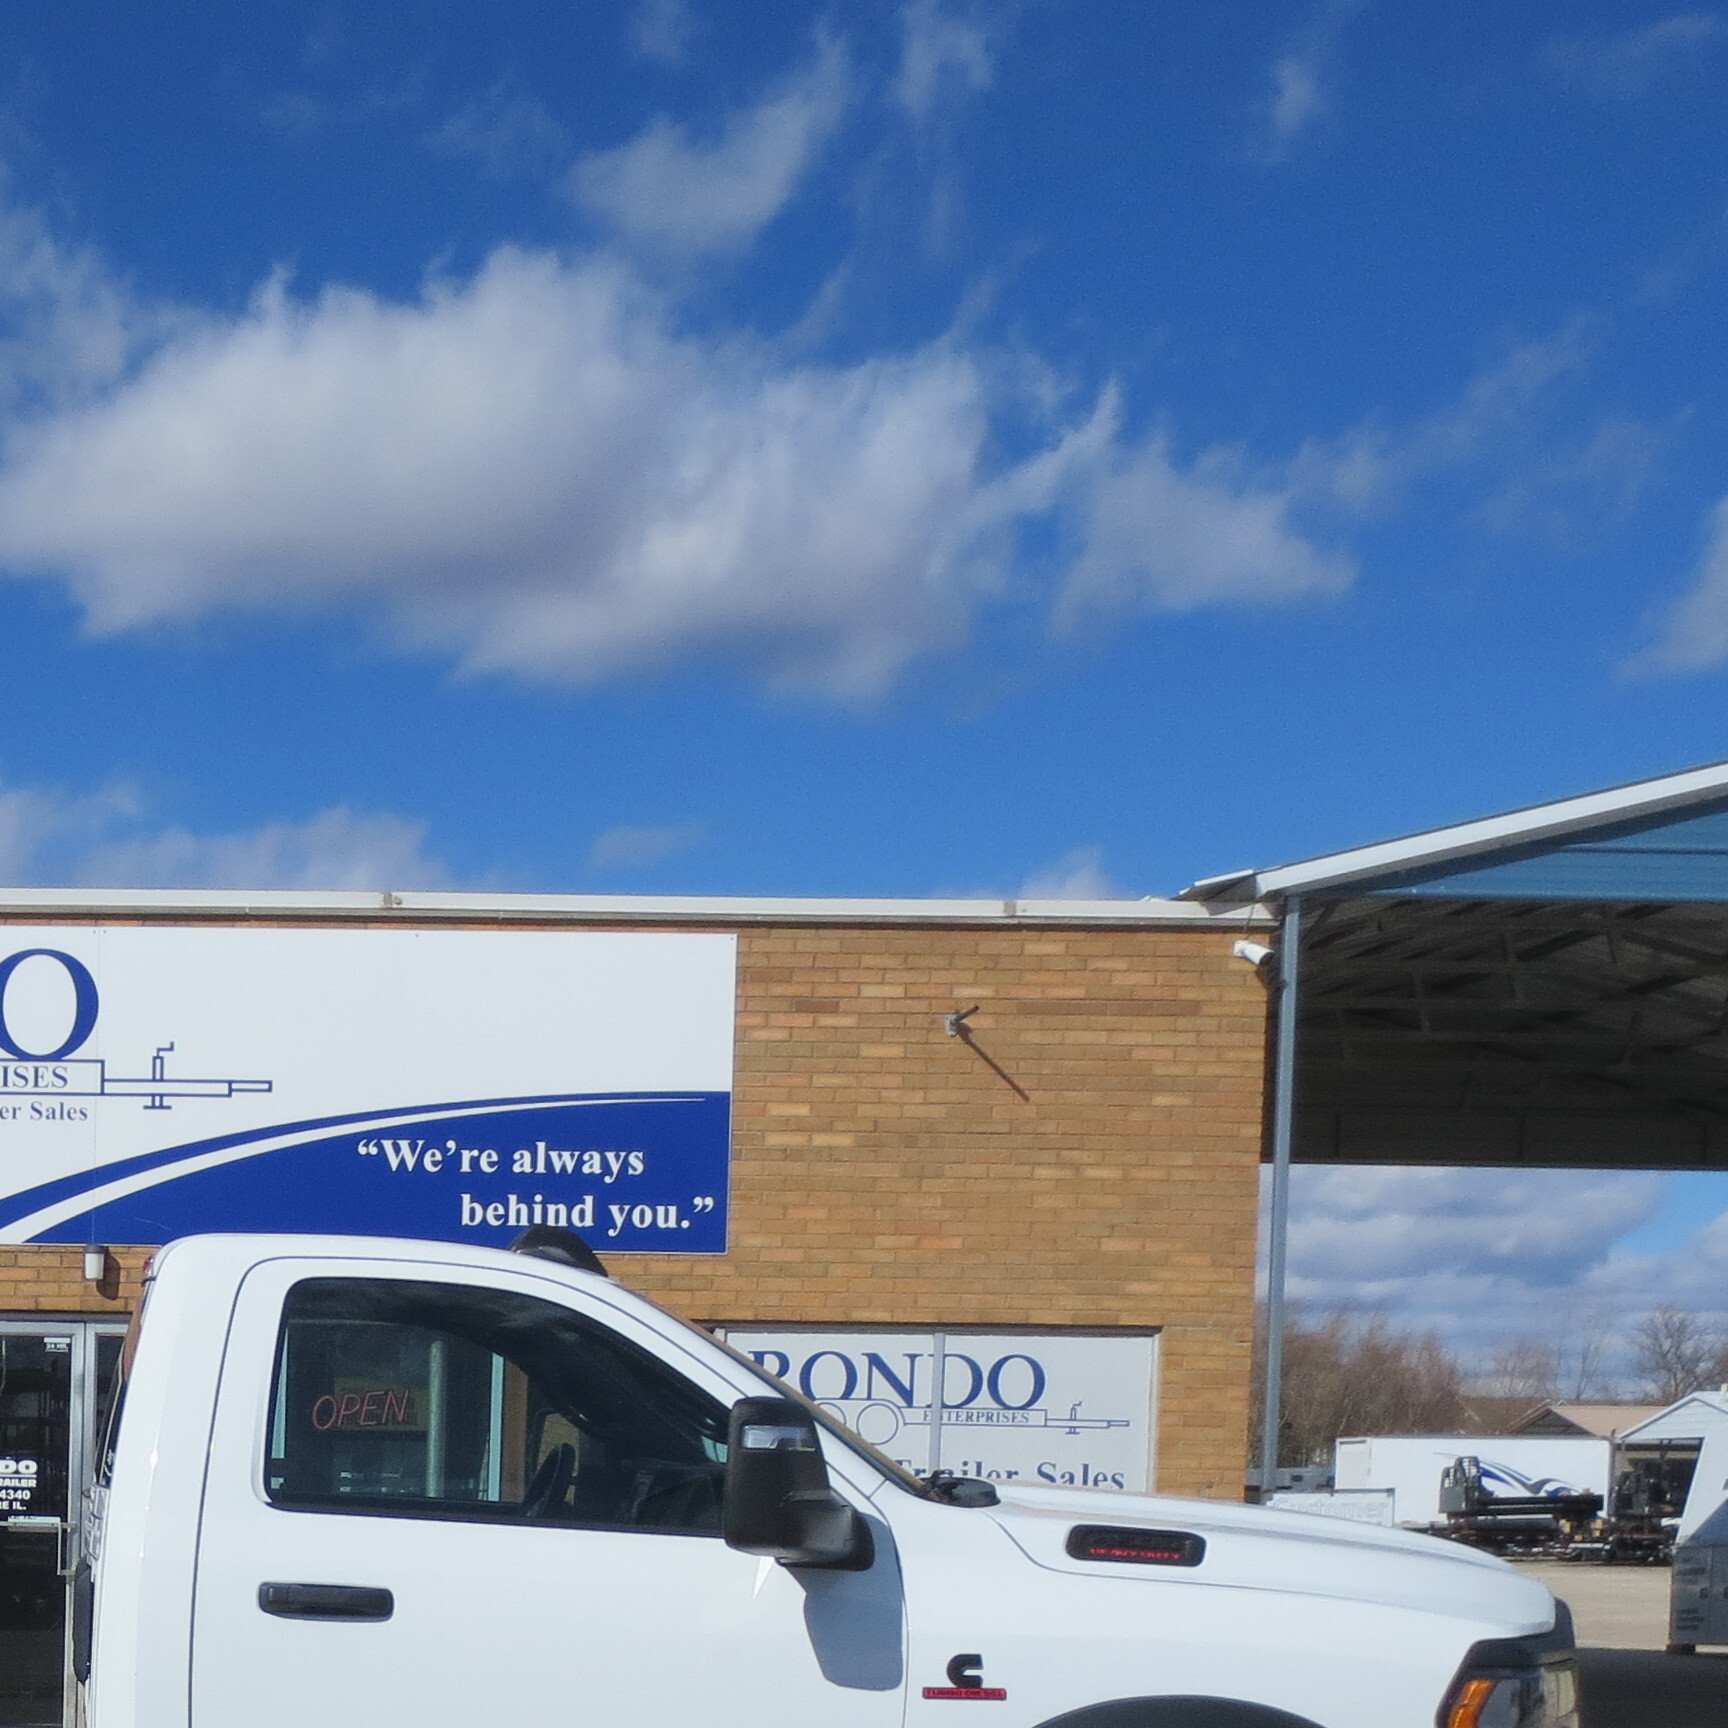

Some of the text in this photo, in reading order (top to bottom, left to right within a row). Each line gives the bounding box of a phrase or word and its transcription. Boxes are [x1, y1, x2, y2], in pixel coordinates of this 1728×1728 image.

[29, 1101, 88, 1122] Sales
[357, 1139, 645, 1184] “We’re always
[460, 1193, 714, 1237] behind you.”
[748, 1350, 1046, 1410] RONDO
[312, 1388, 409, 1430] OPEN
[1037, 1461, 1125, 1489] Sales
[12, 1501, 27, 1510] IL.
